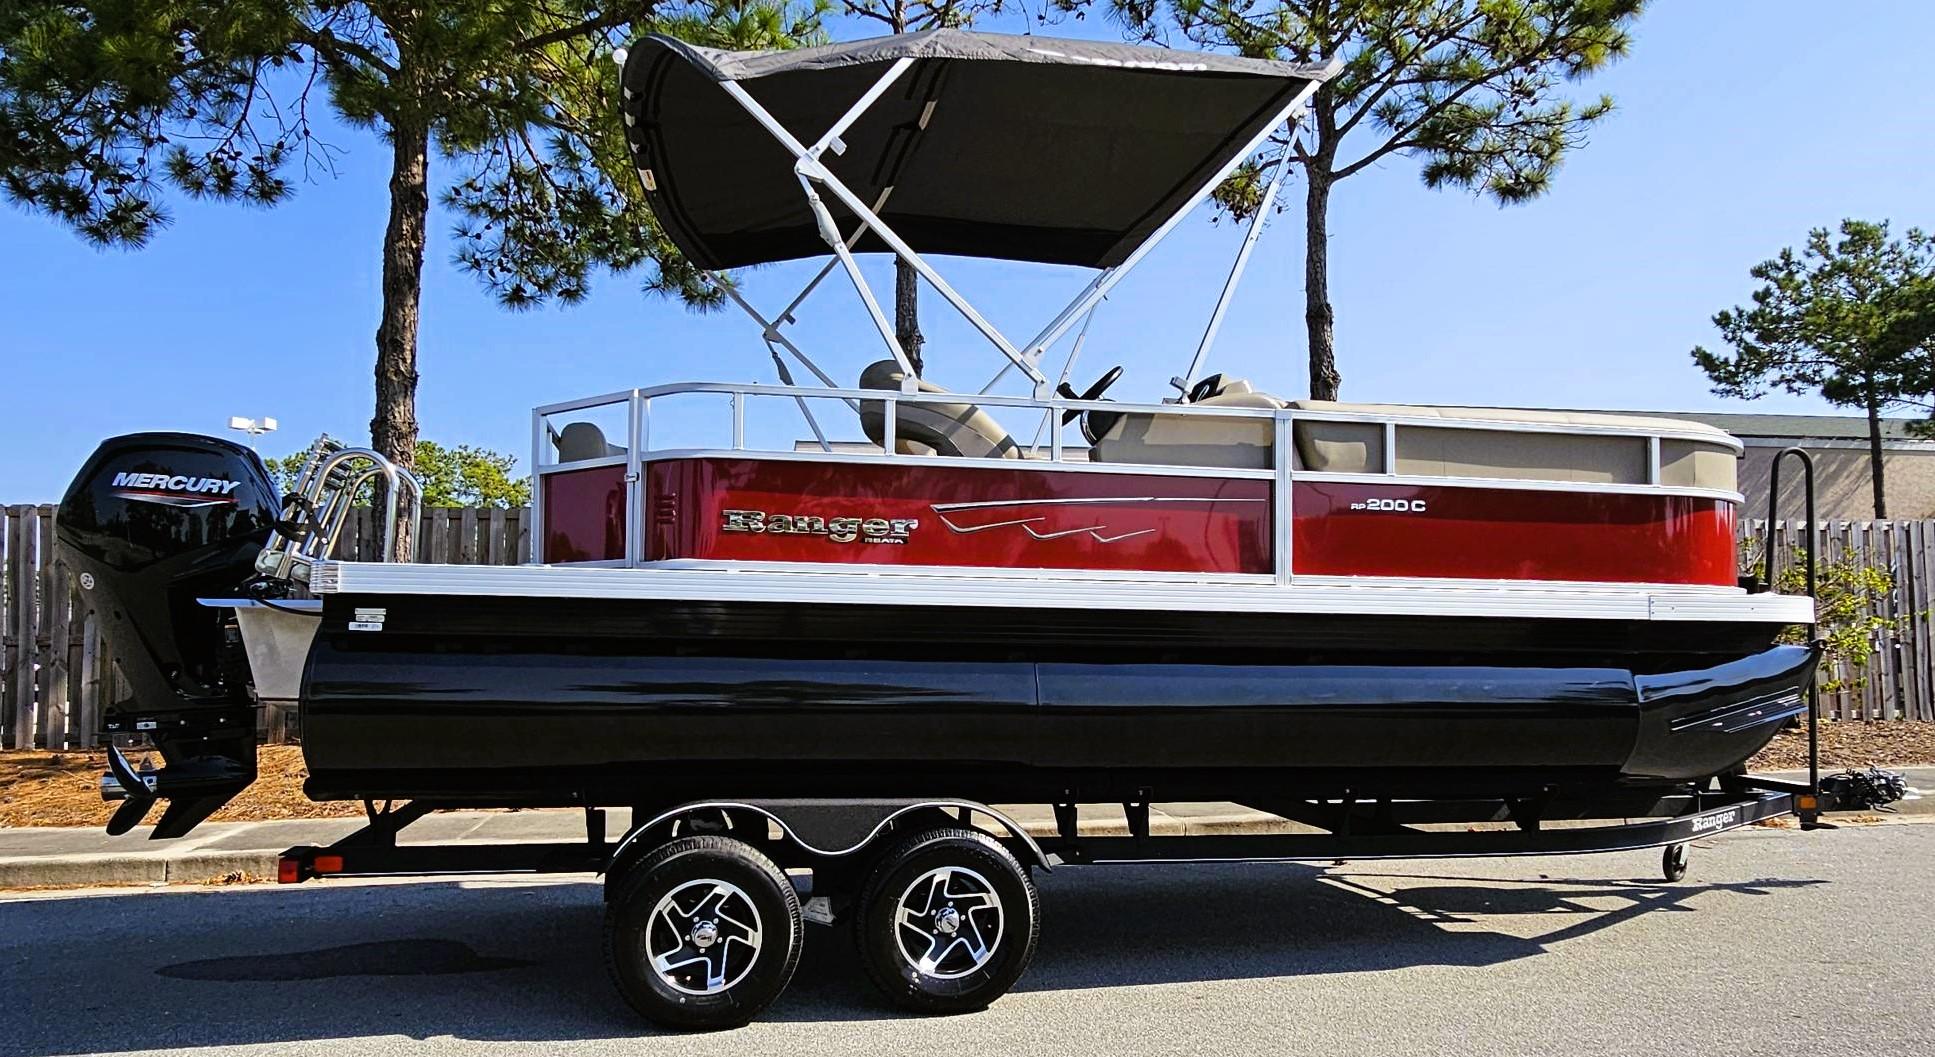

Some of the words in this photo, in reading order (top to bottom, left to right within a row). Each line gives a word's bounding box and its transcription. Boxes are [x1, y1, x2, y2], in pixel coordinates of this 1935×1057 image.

[112, 472, 241, 494] MERCURY
[722, 509, 919, 543] Ranger
[1691, 810, 1736, 832] Ranger
